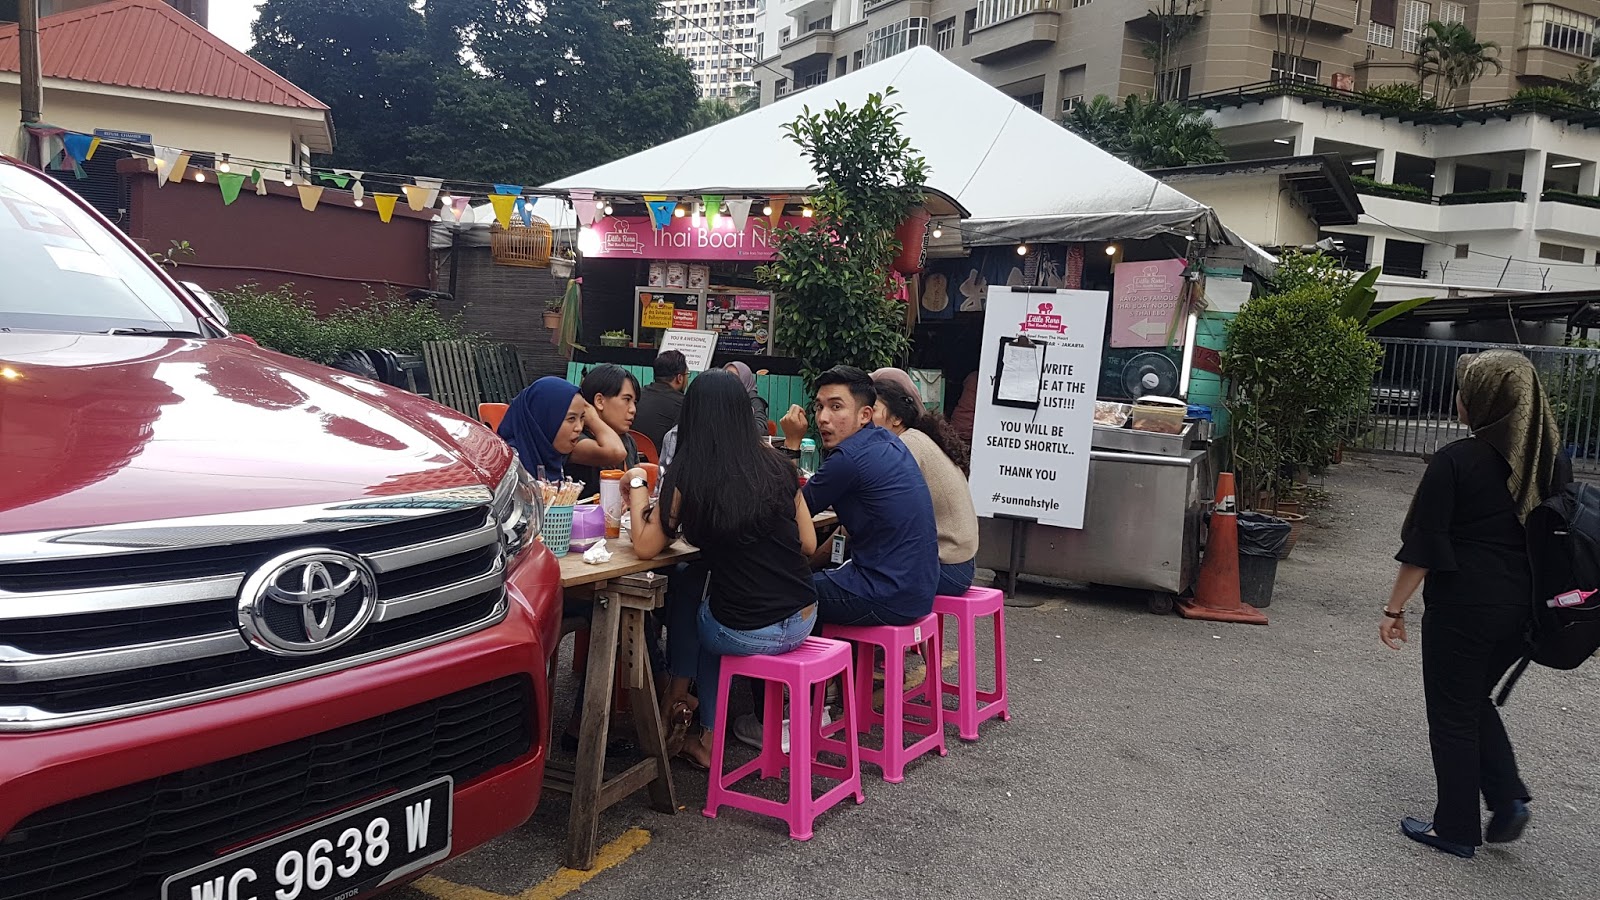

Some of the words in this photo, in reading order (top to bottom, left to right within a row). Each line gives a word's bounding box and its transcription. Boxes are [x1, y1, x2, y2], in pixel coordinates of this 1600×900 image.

[653, 226, 691, 248] Thai
[697, 226, 746, 249] Boat
[1027, 314, 1044, 324] Little
[1042, 363, 1074, 376] WRITE
[1050, 380, 1064, 392] AT
[1066, 381, 1086, 394] THE
[1043, 396, 1075, 410] LIST!!!
[1000, 420, 1021, 433] YOU
[1024, 422, 1048, 436] WILL
[1051, 425, 1064, 437] BE
[986, 435, 1022, 449] SEATED
[999, 464, 1033, 479] THANK
[1035, 468, 1057, 481] YOU
[991, 492, 1060, 511] #sunnahstyle
[274, 816, 391, 900] 9638
[405, 798, 432, 854] W
